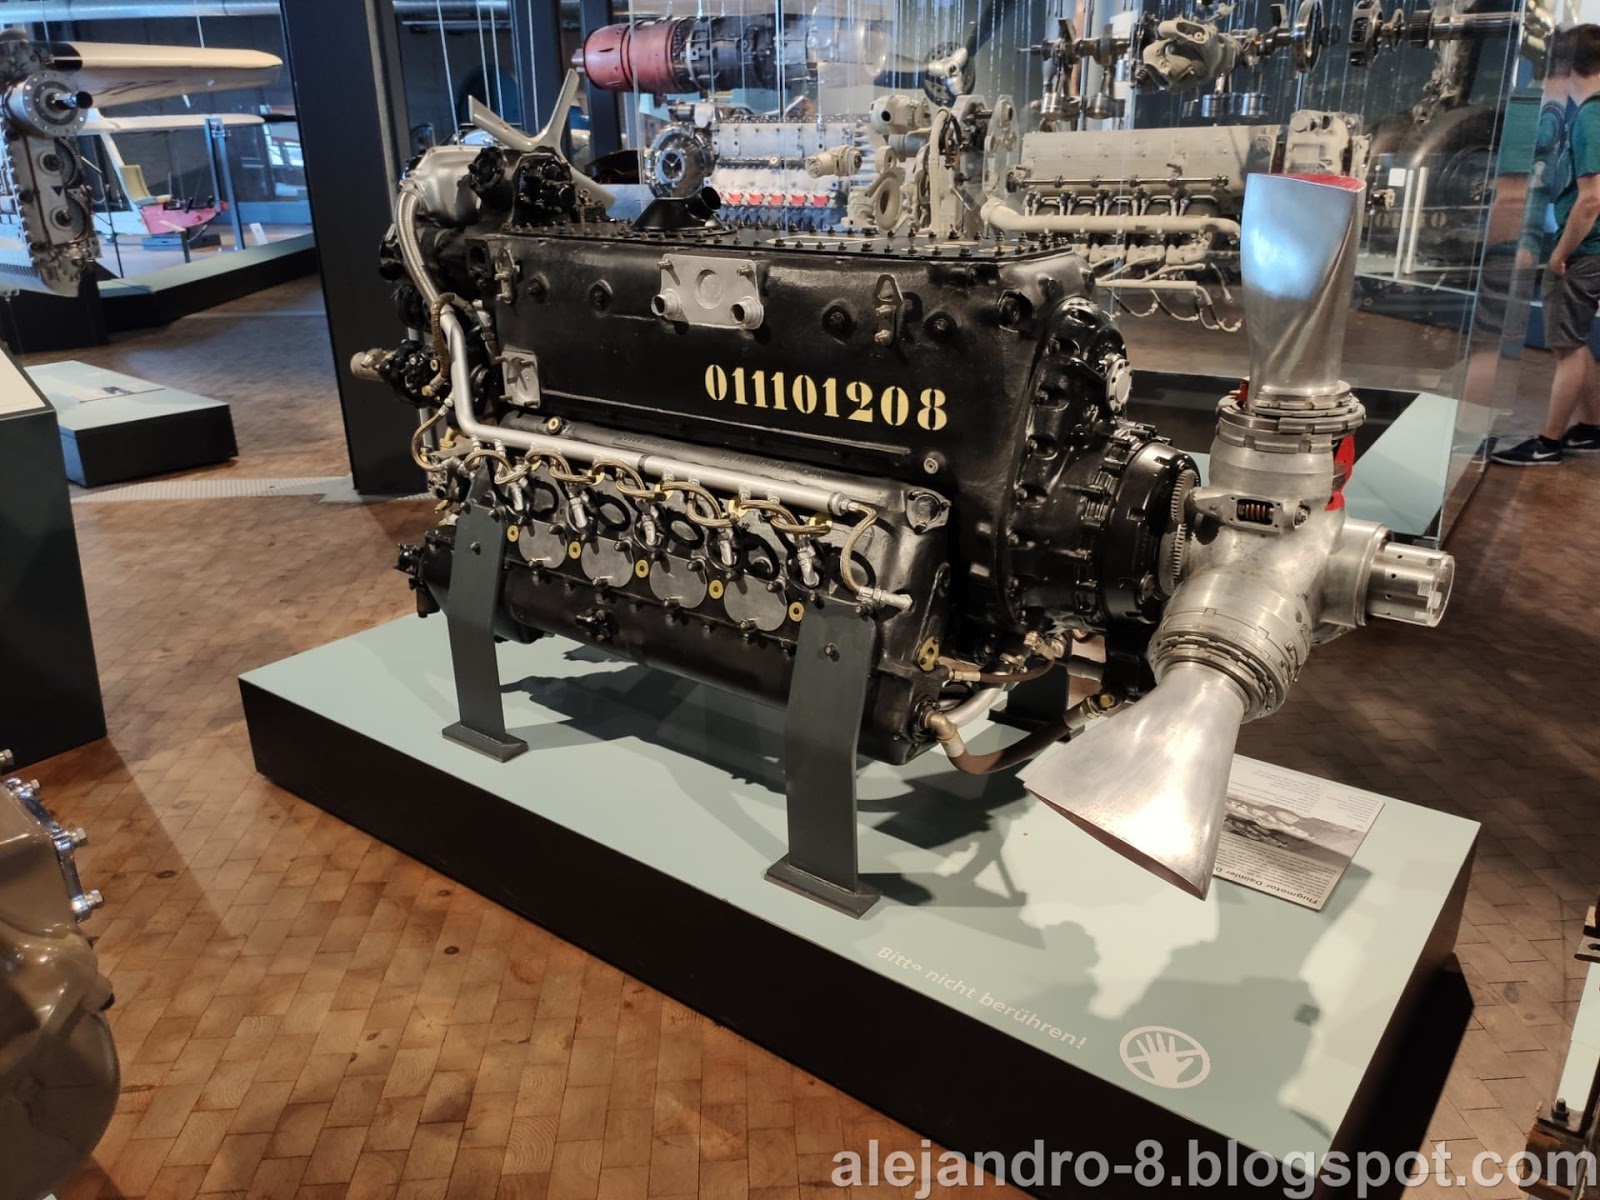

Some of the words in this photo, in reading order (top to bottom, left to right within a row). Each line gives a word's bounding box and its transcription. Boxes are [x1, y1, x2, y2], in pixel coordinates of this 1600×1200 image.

[705, 364, 947, 431] 011101208
[1226, 870, 1263, 886] Daimler
[1267, 884, 1318, 905] Flugmotor
[925, 970, 977, 999] nicht
[979, 992, 1087, 1048] berühren!
